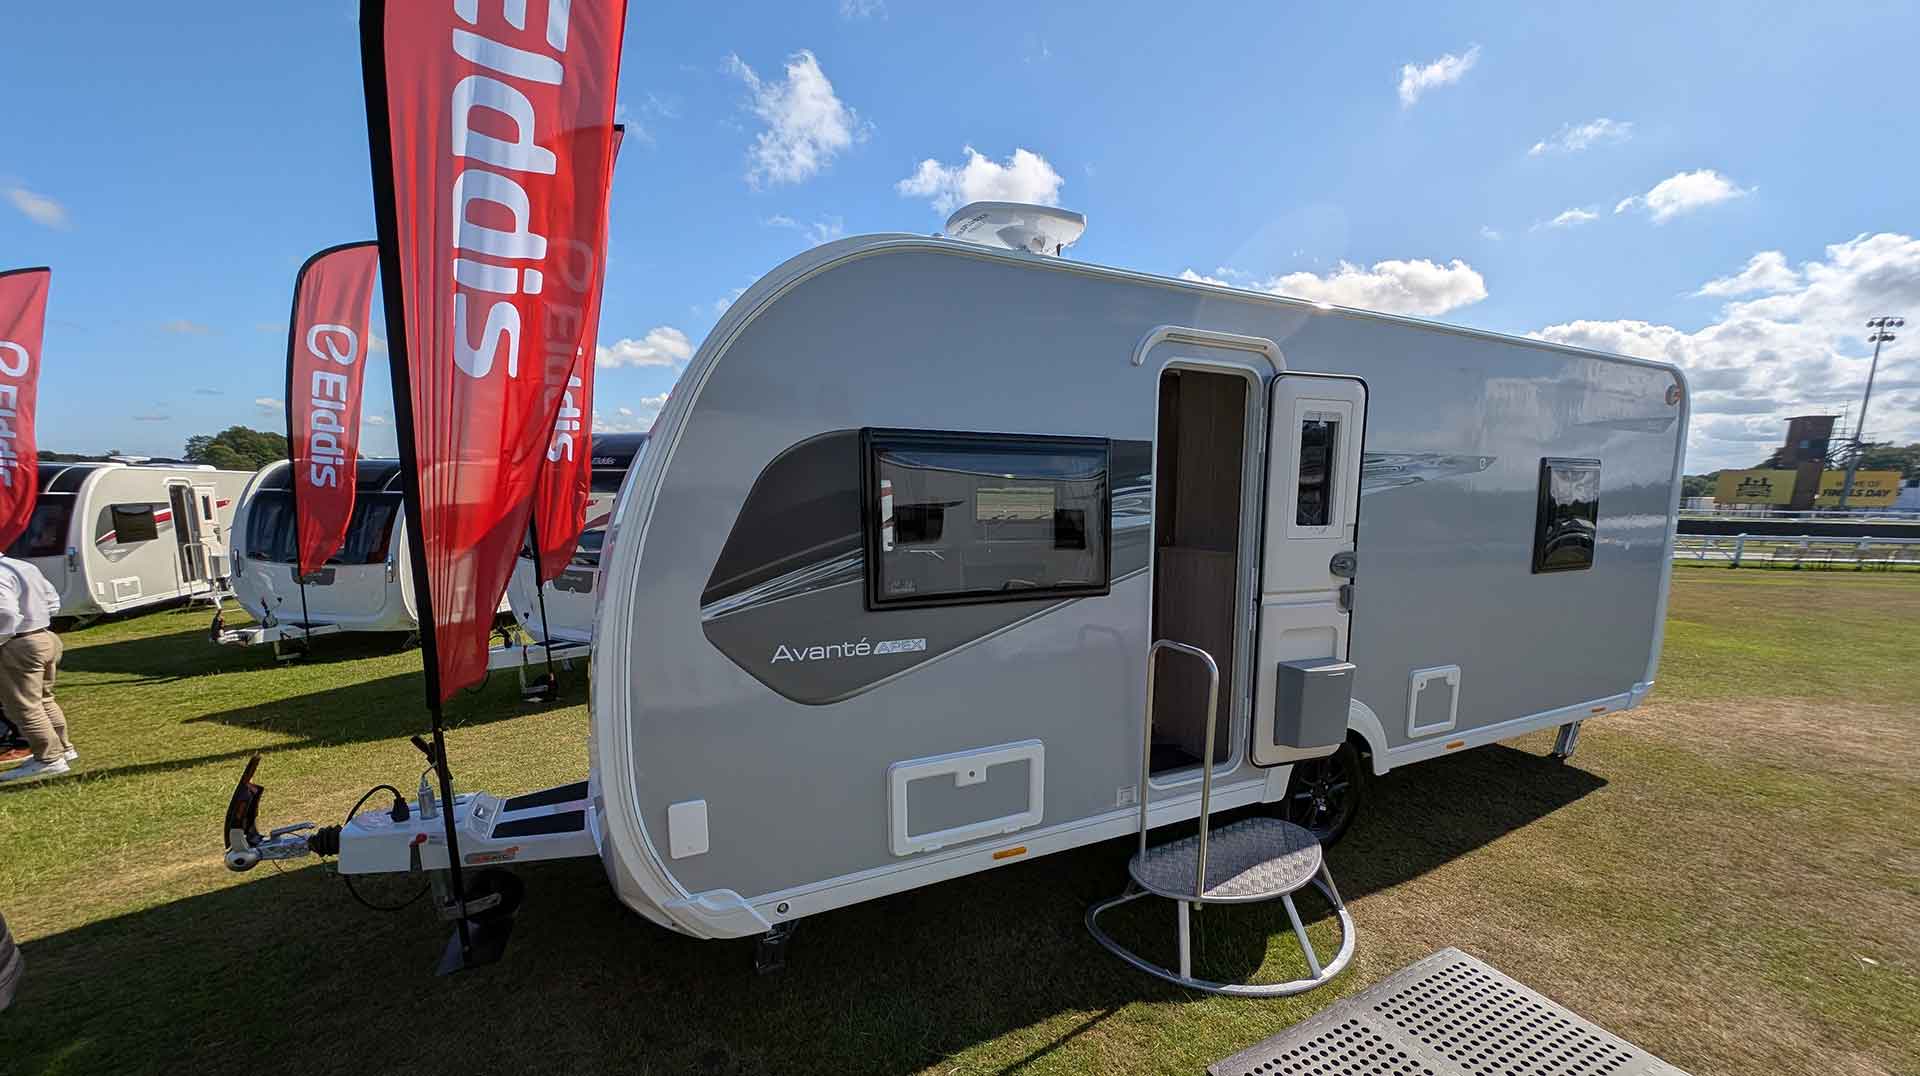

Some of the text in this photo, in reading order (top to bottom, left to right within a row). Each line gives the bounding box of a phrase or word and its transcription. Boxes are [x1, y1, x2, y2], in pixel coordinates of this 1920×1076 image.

[310, 370, 348, 488] Elddis
[771, 637, 924, 664] Avanté APEX
